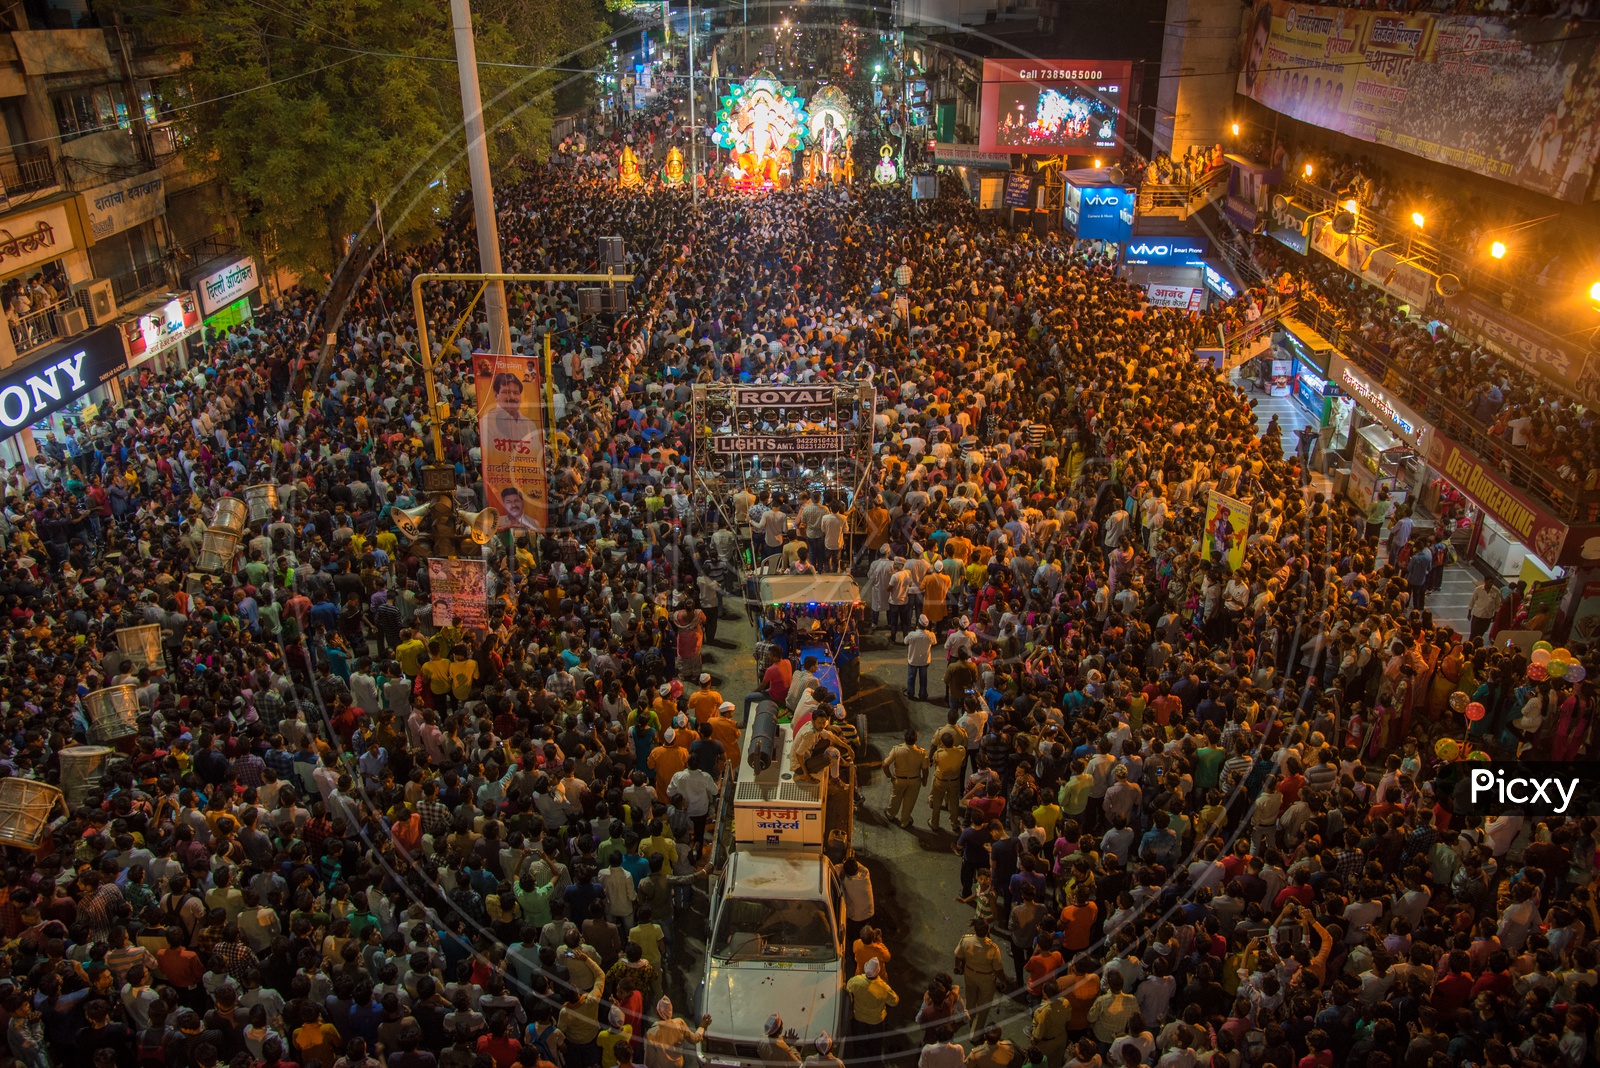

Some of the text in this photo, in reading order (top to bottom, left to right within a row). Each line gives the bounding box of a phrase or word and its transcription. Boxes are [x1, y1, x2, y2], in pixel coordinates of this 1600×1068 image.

[1464, 34, 1479, 49] 27
[1020, 70, 1102, 79] Call 7385055000
[1086, 194, 1118, 205] vivo
[1271, 207, 1304, 232] oppo
[1130, 243, 1168, 255] vivo
[742, 390, 831, 404] ROYAL
[493, 437, 531, 455] भाऊ
[721, 438, 776, 451] LIGHTS
[486, 462, 541, 475] वाढदिवसाच्या
[1445, 446, 1472, 486] DESI
[1466, 464, 1536, 538] BURGERKING
[756, 808, 799, 820] राजा
[756, 819, 800, 830] जनरेटर्स
